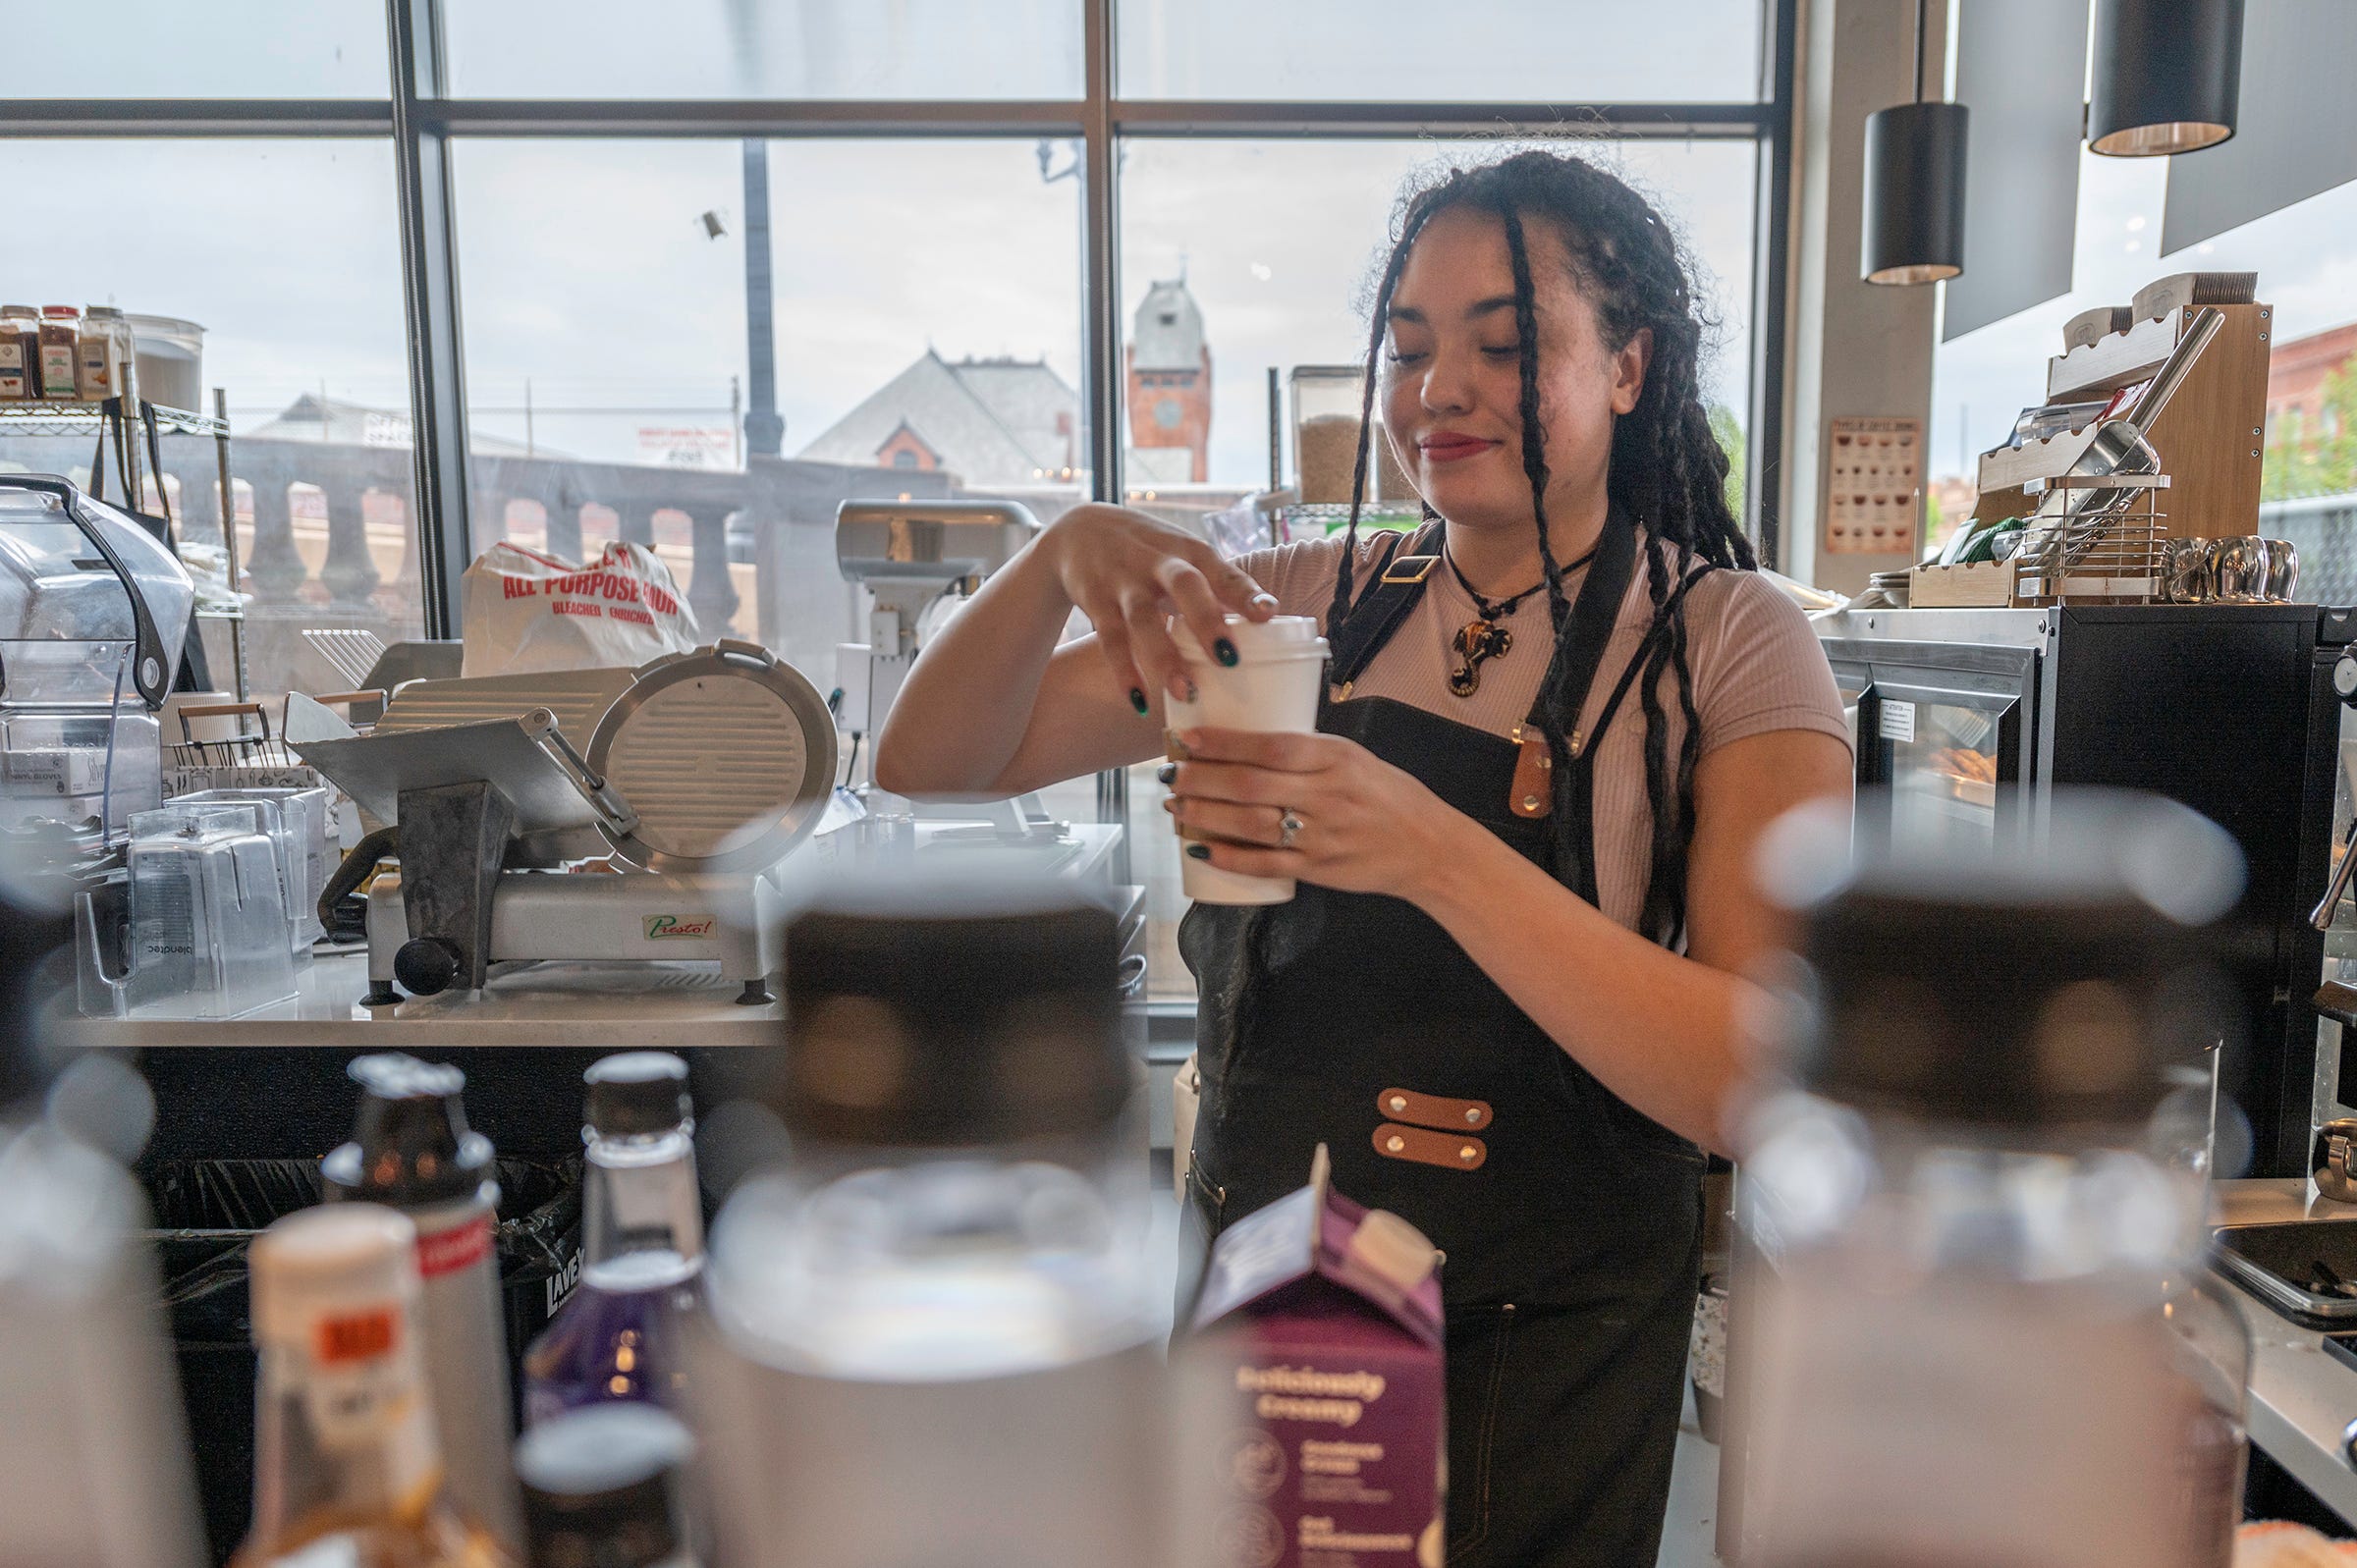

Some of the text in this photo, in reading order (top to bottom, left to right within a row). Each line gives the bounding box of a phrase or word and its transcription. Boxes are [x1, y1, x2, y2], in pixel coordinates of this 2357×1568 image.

[503, 575, 536, 601] ALL
[544, 571, 637, 603] PURPOSE
[552, 601, 654, 625] BLEACHED ENRICHED
[648, 915, 712, 939] Presto!
[146, 945, 193, 956] blendtec
[546, 1247, 585, 1319] LAVEX
